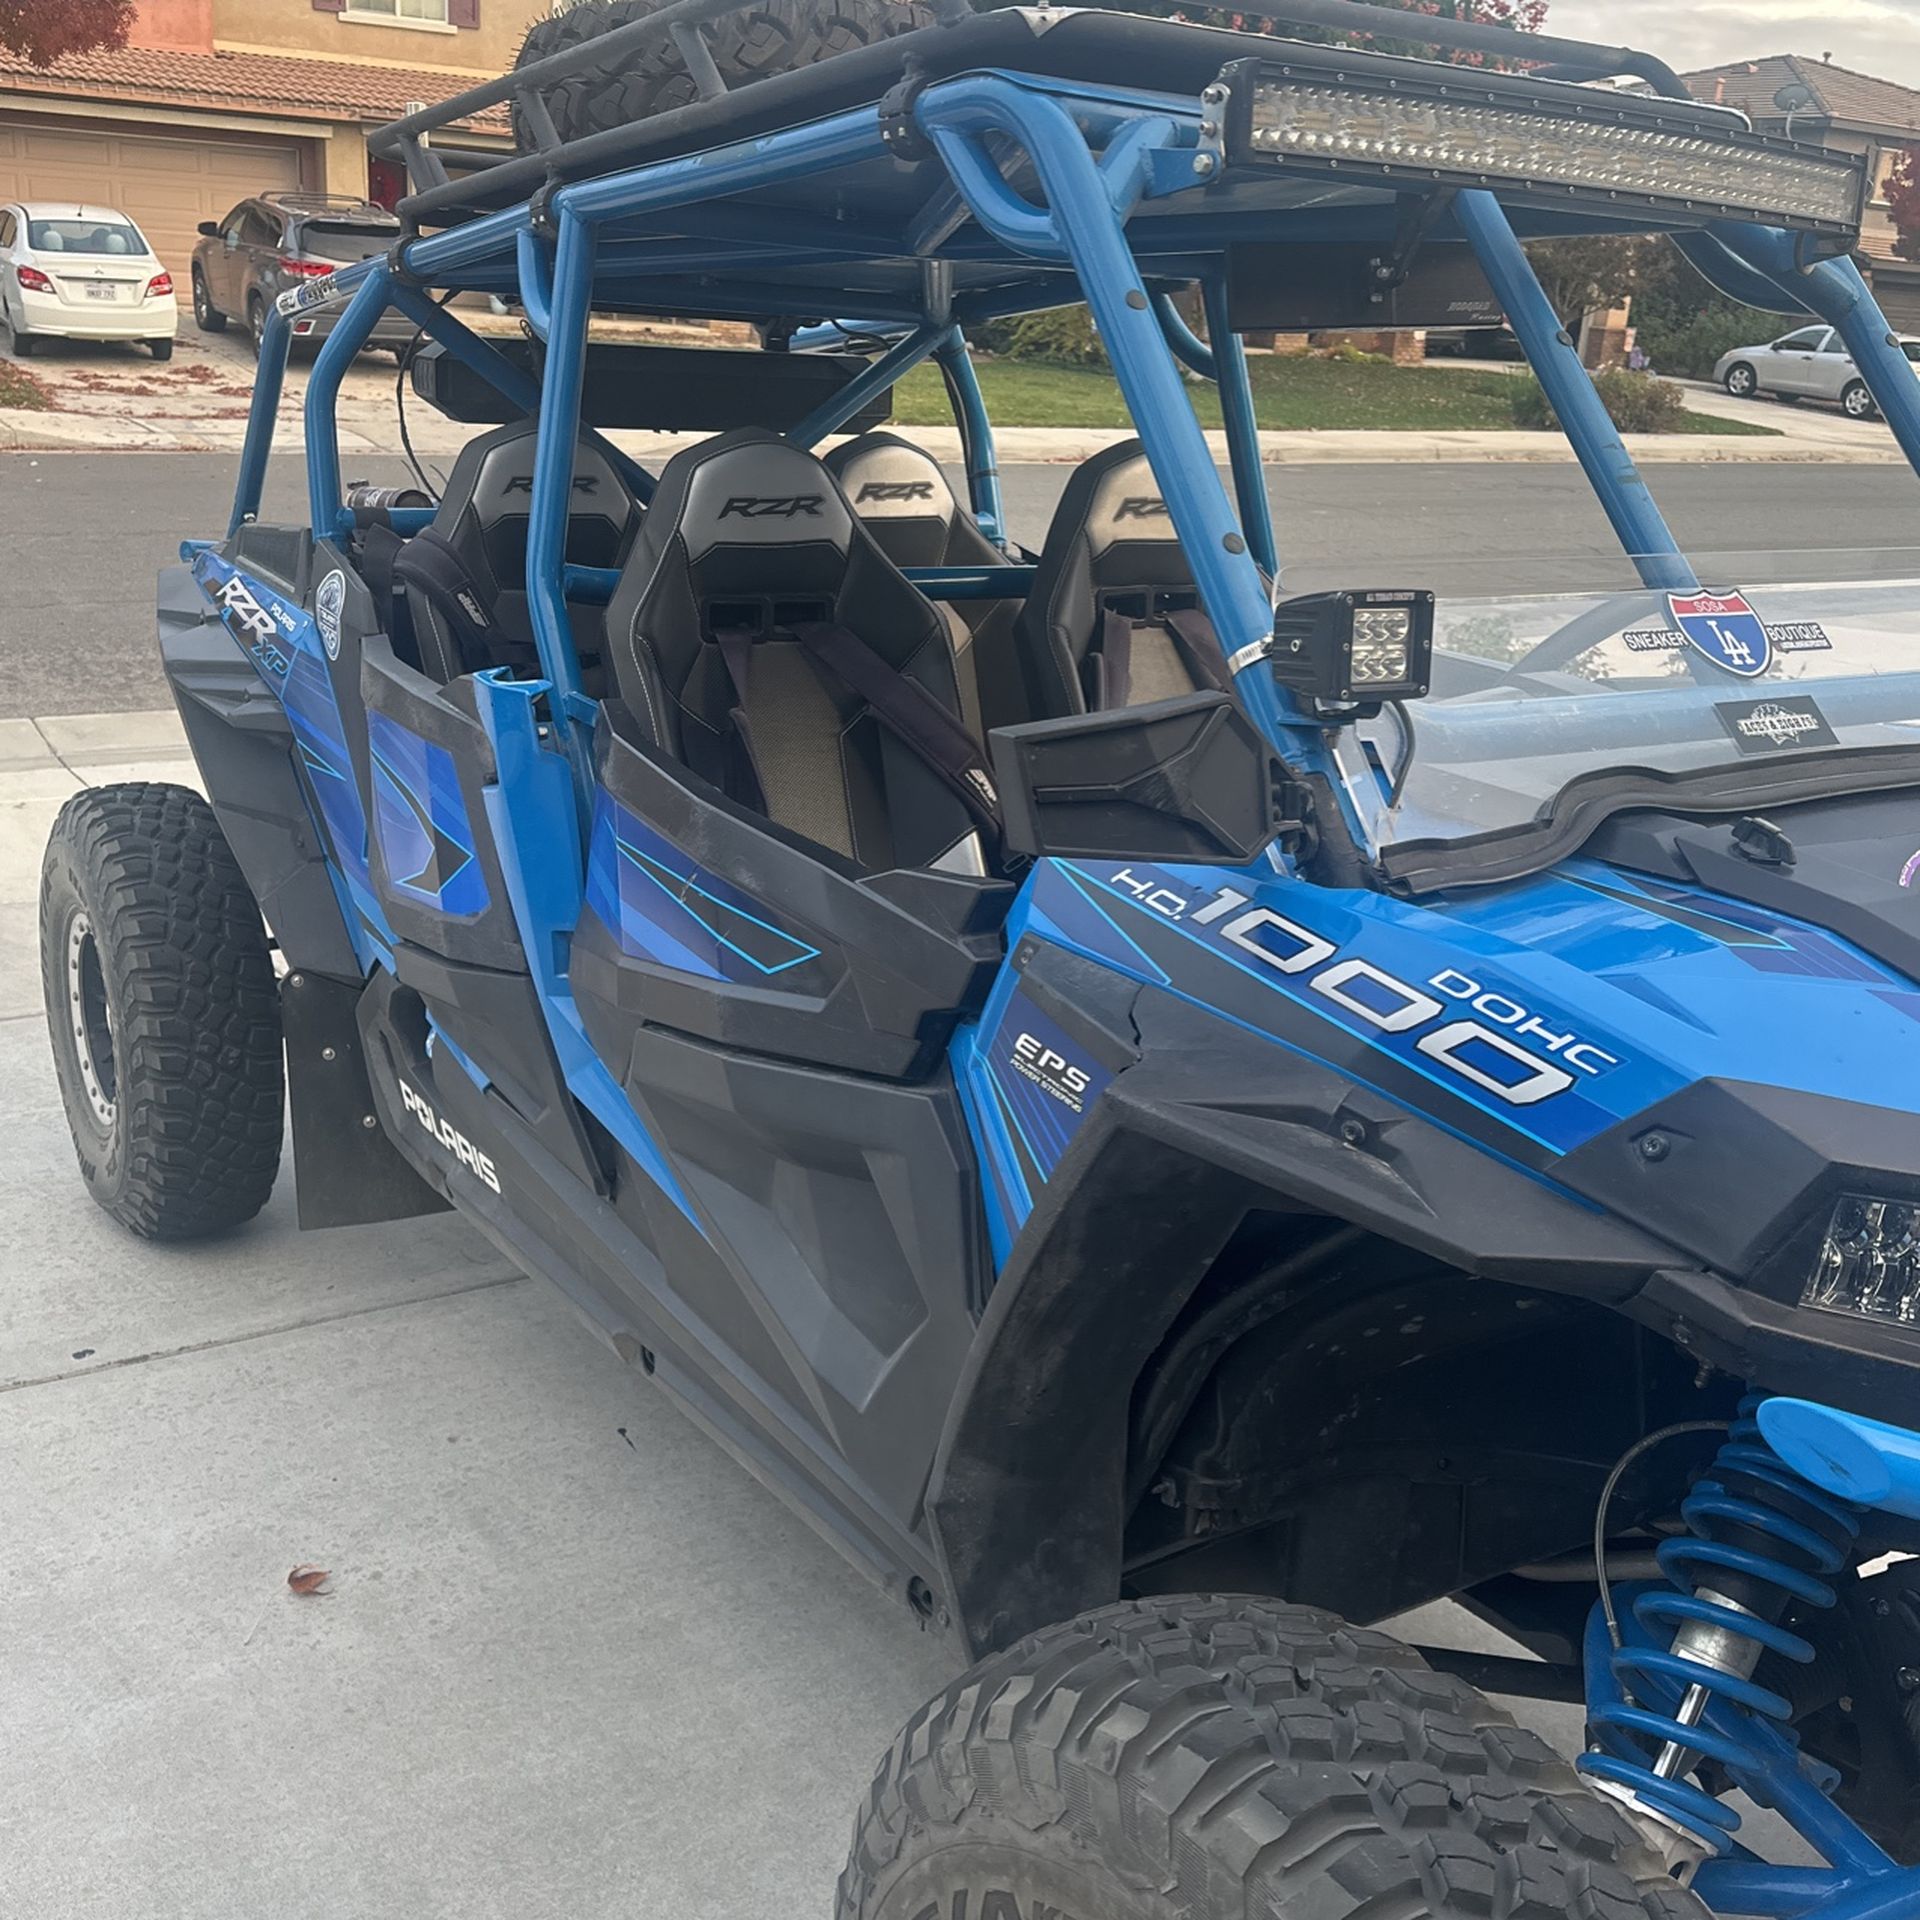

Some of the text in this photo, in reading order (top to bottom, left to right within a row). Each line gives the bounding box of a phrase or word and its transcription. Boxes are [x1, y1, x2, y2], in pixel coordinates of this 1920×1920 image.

[502, 476, 600, 495] RR
[855, 481, 934, 504] RZR
[718, 496, 825, 520] RZR
[1113, 497, 1168, 522] RZ
[215, 576, 277, 644] RZR
[270, 602, 297, 633] POLARIS
[1693, 600, 1728, 613] SOSA
[1624, 632, 1688, 650] SNEAKER
[1706, 620, 1757, 666] LA
[1767, 625, 1825, 642] BOUTIQUE
[251, 637, 290, 675] XP
[1190, 886, 1575, 1106] 1000
[1427, 968, 1618, 1076] DOHC
[1014, 1032, 1092, 1093] EPS
[399, 1078, 501, 1194] POLARIS
